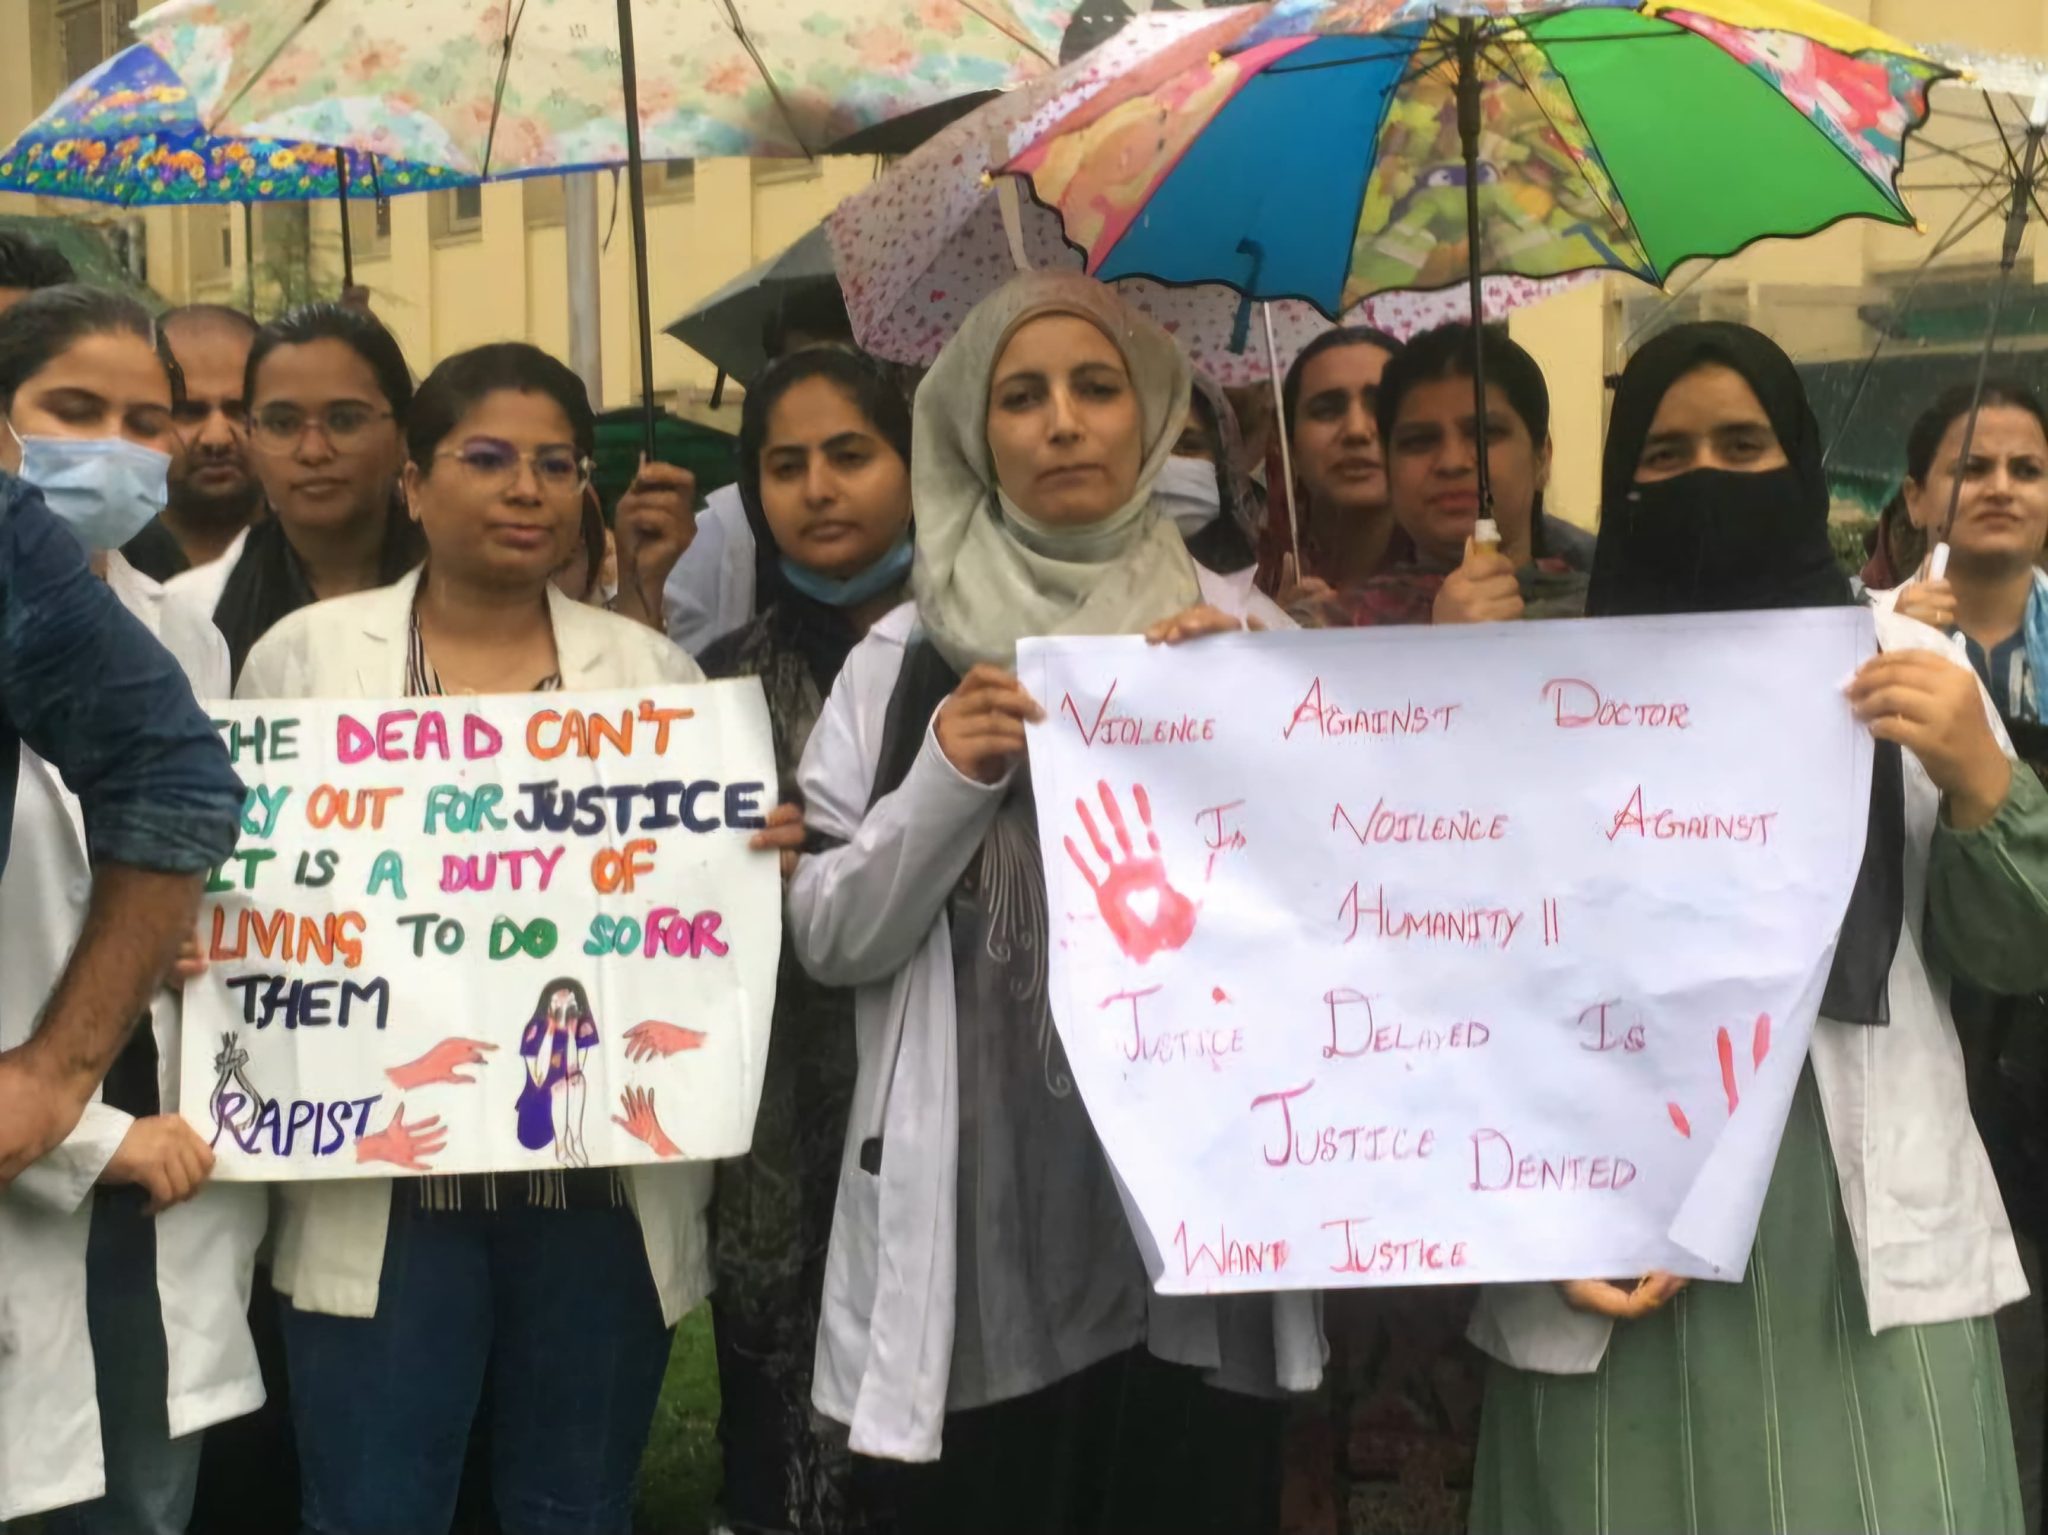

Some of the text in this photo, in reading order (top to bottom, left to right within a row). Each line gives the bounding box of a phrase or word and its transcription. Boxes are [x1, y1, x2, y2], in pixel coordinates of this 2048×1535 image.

[209, 699, 695, 764] HE DEAD CAN'T
[1283, 676, 1459, 740] AGAINST
[239, 779, 766, 839] RY OUT FOR JUSTICE
[1606, 784, 1778, 844] AGAINST
[294, 849, 340, 887] IS
[366, 850, 408, 899] A
[438, 846, 566, 893] DUTY
[590, 839, 657, 894] OF
[209, 904, 729, 968] LIVING TO DO SO FOR
[226, 974, 390, 1030] THEM
[209, 1092, 383, 1157] RAPIST
